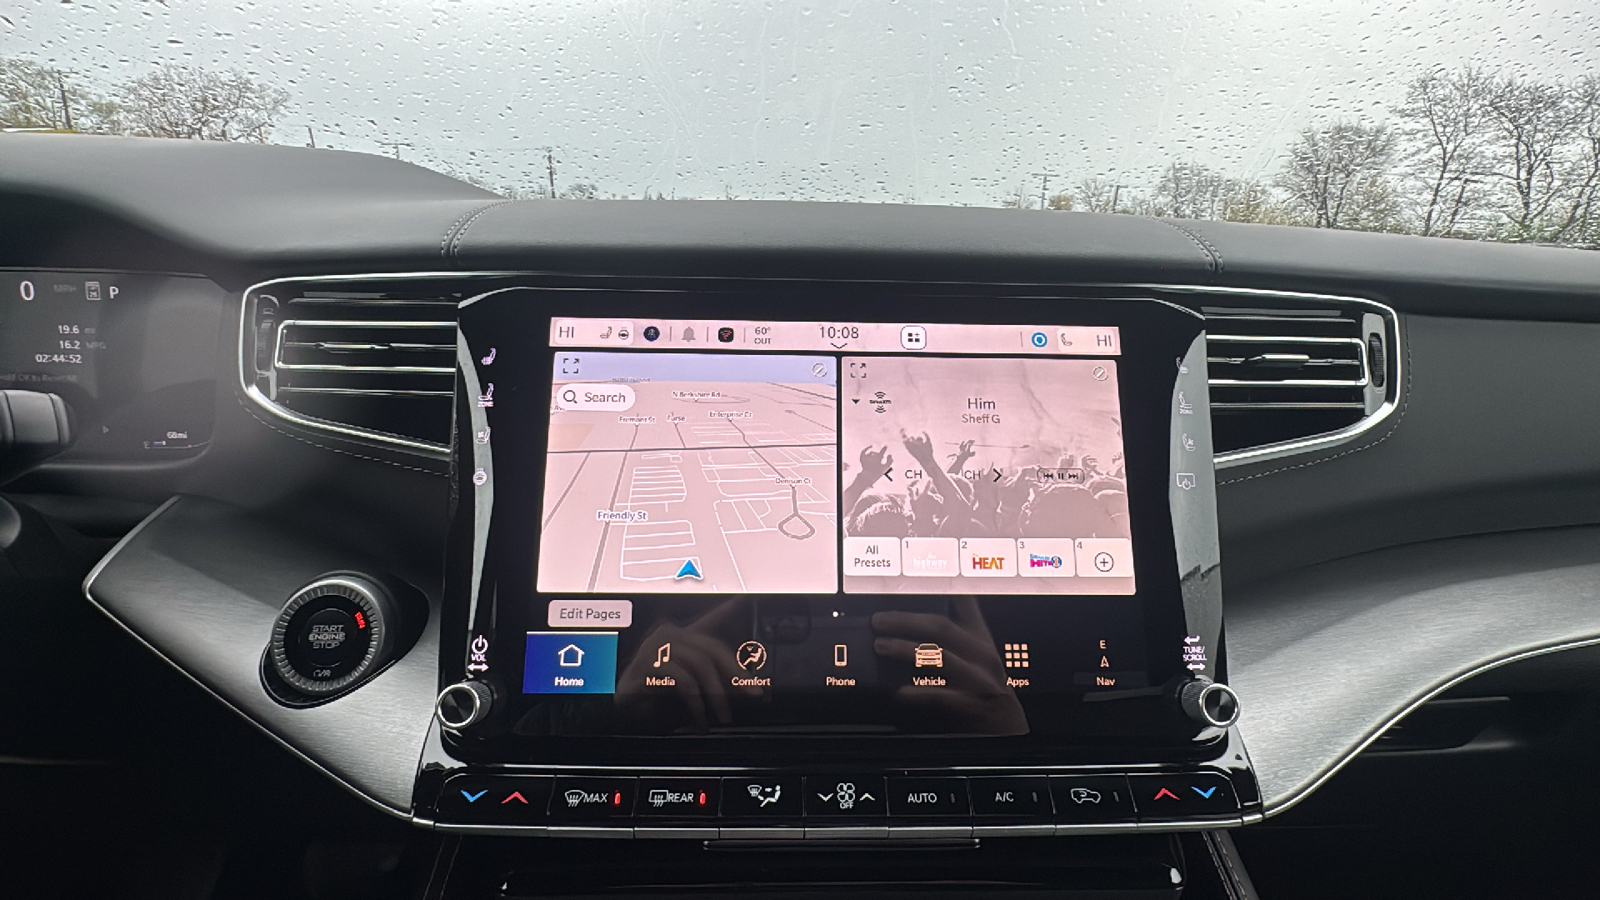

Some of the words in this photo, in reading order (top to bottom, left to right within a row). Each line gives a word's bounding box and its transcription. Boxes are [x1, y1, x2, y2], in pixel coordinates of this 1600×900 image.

[20, 280, 35, 300] 0
[109, 286, 119, 299] P
[58, 324, 80, 334] 19.6
[559, 326, 575, 338] HI
[819, 326, 859, 339] 10:08
[59, 340, 81, 350] 16.2
[754, 337, 772, 345] OUT
[1096, 335, 1112, 347] HI
[35, 353, 82, 364] 02:44:52
[584, 391, 626, 403] Search
[967, 397, 996, 411] Him
[961, 413, 989, 425] Sheff
[991, 413, 1001, 425] G
[905, 469, 923, 480] CH
[964, 470, 982, 481] CH
[597, 511, 634, 521] Friendly
[636, 511, 648, 520] St
[866, 545, 879, 555] All
[905, 540, 910, 549] 1
[961, 540, 968, 550] 2
[1019, 541, 1026, 550] 3
[1076, 541, 1084, 550] 4
[854, 558, 891, 568] Presets
[913, 556, 947, 569] highway
[972, 557, 1005, 570] HEAT
[559, 608, 583, 620] Edit
[586, 609, 621, 622] Pages
[312, 624, 344, 632] START
[308, 633, 346, 641] ENGINE
[312, 641, 341, 649] STOP
[1099, 639, 1107, 650] E
[1182, 645, 1206, 654] TUNE/
[470, 653, 487, 662] VOL
[1182, 653, 1208, 662] SCROLL
[554, 676, 585, 687] Home
[646, 676, 676, 687] Media
[731, 676, 771, 687] Comfort
[826, 676, 856, 687] Phone
[912, 676, 946, 687] Vehicle
[1006, 676, 1030, 689] Apps
[1096, 676, 1116, 686] Nav
[584, 793, 608, 803] MAX
[667, 793, 694, 803] REAR
[907, 793, 938, 803] AUTO
[994, 792, 1015, 803] A/C
